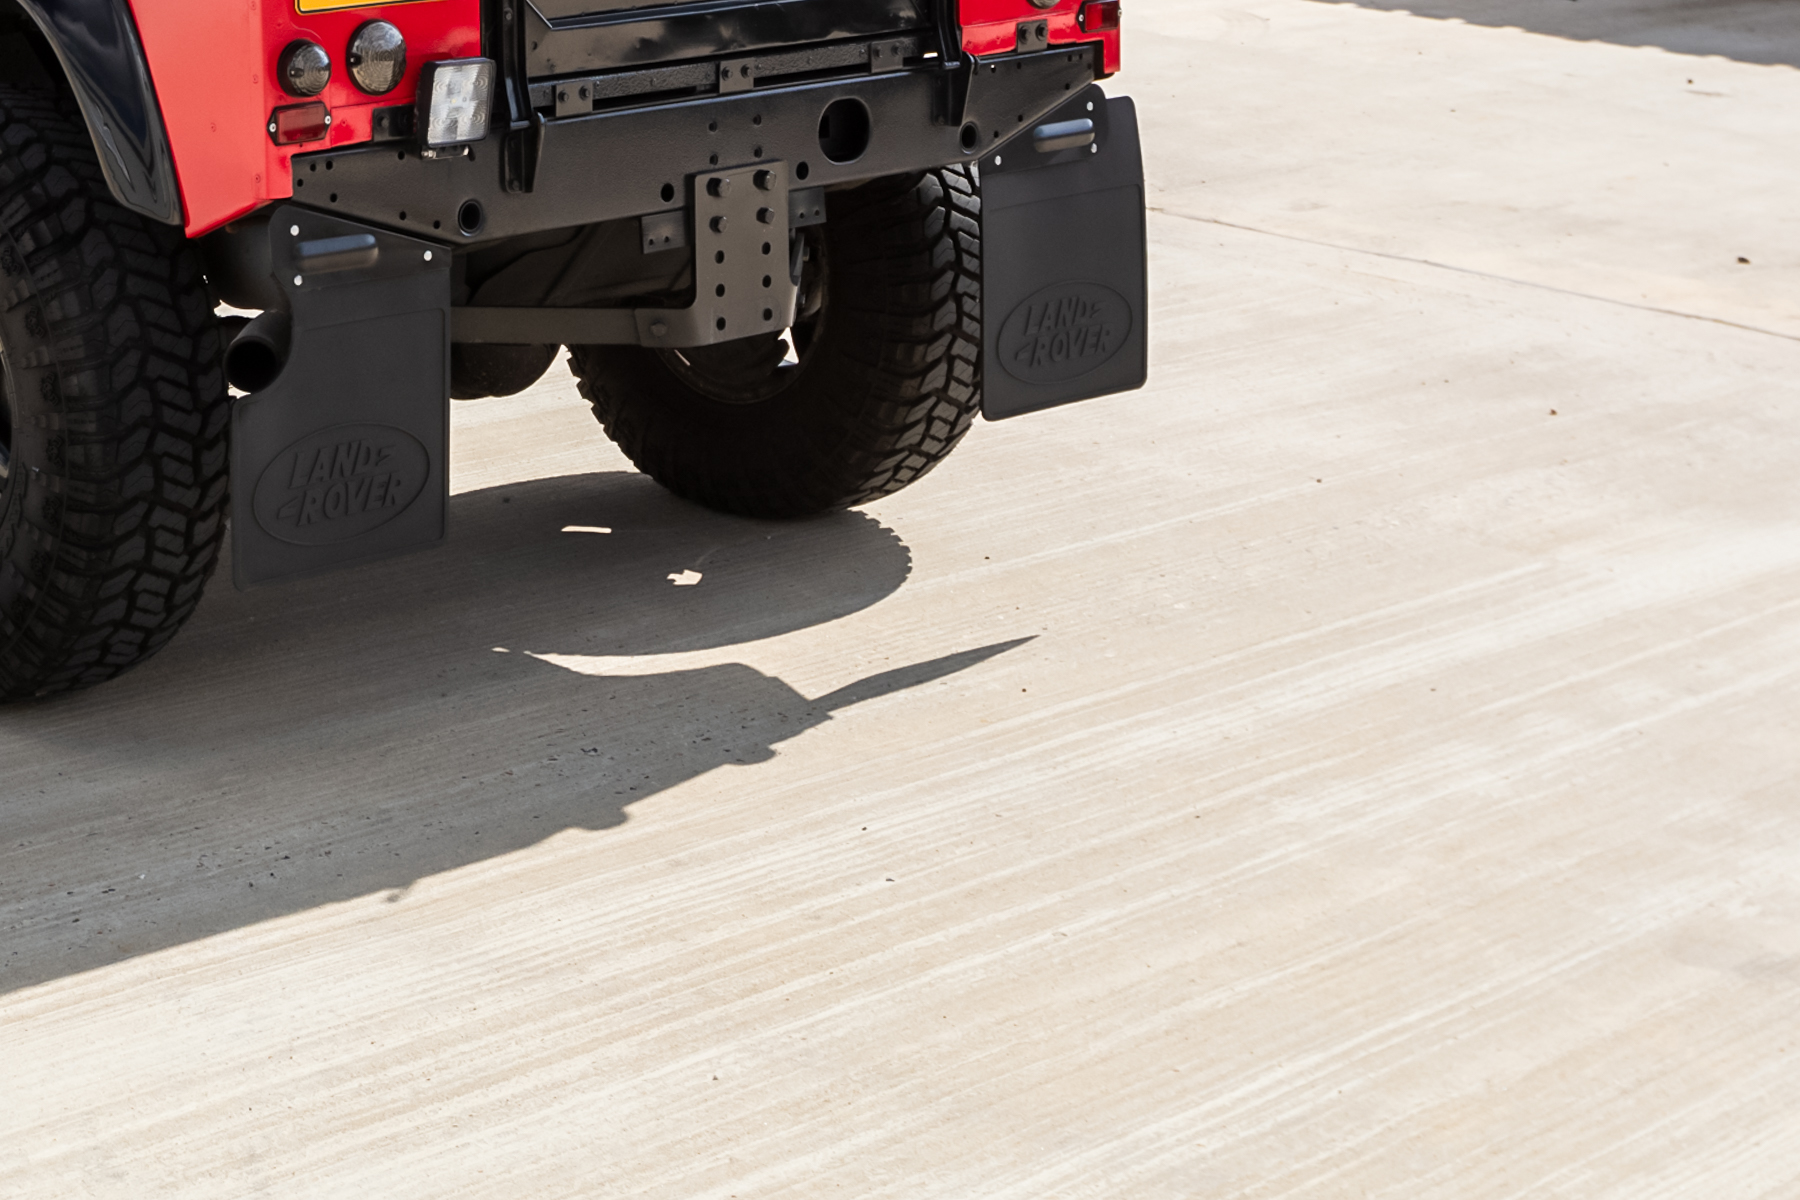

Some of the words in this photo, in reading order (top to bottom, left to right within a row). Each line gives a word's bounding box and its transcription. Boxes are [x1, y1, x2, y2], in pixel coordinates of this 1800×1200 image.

[1023, 295, 1087, 337] LAND
[1028, 323, 1111, 368] ROVER
[287, 439, 372, 490] LAND
[295, 471, 402, 528] ROVER
